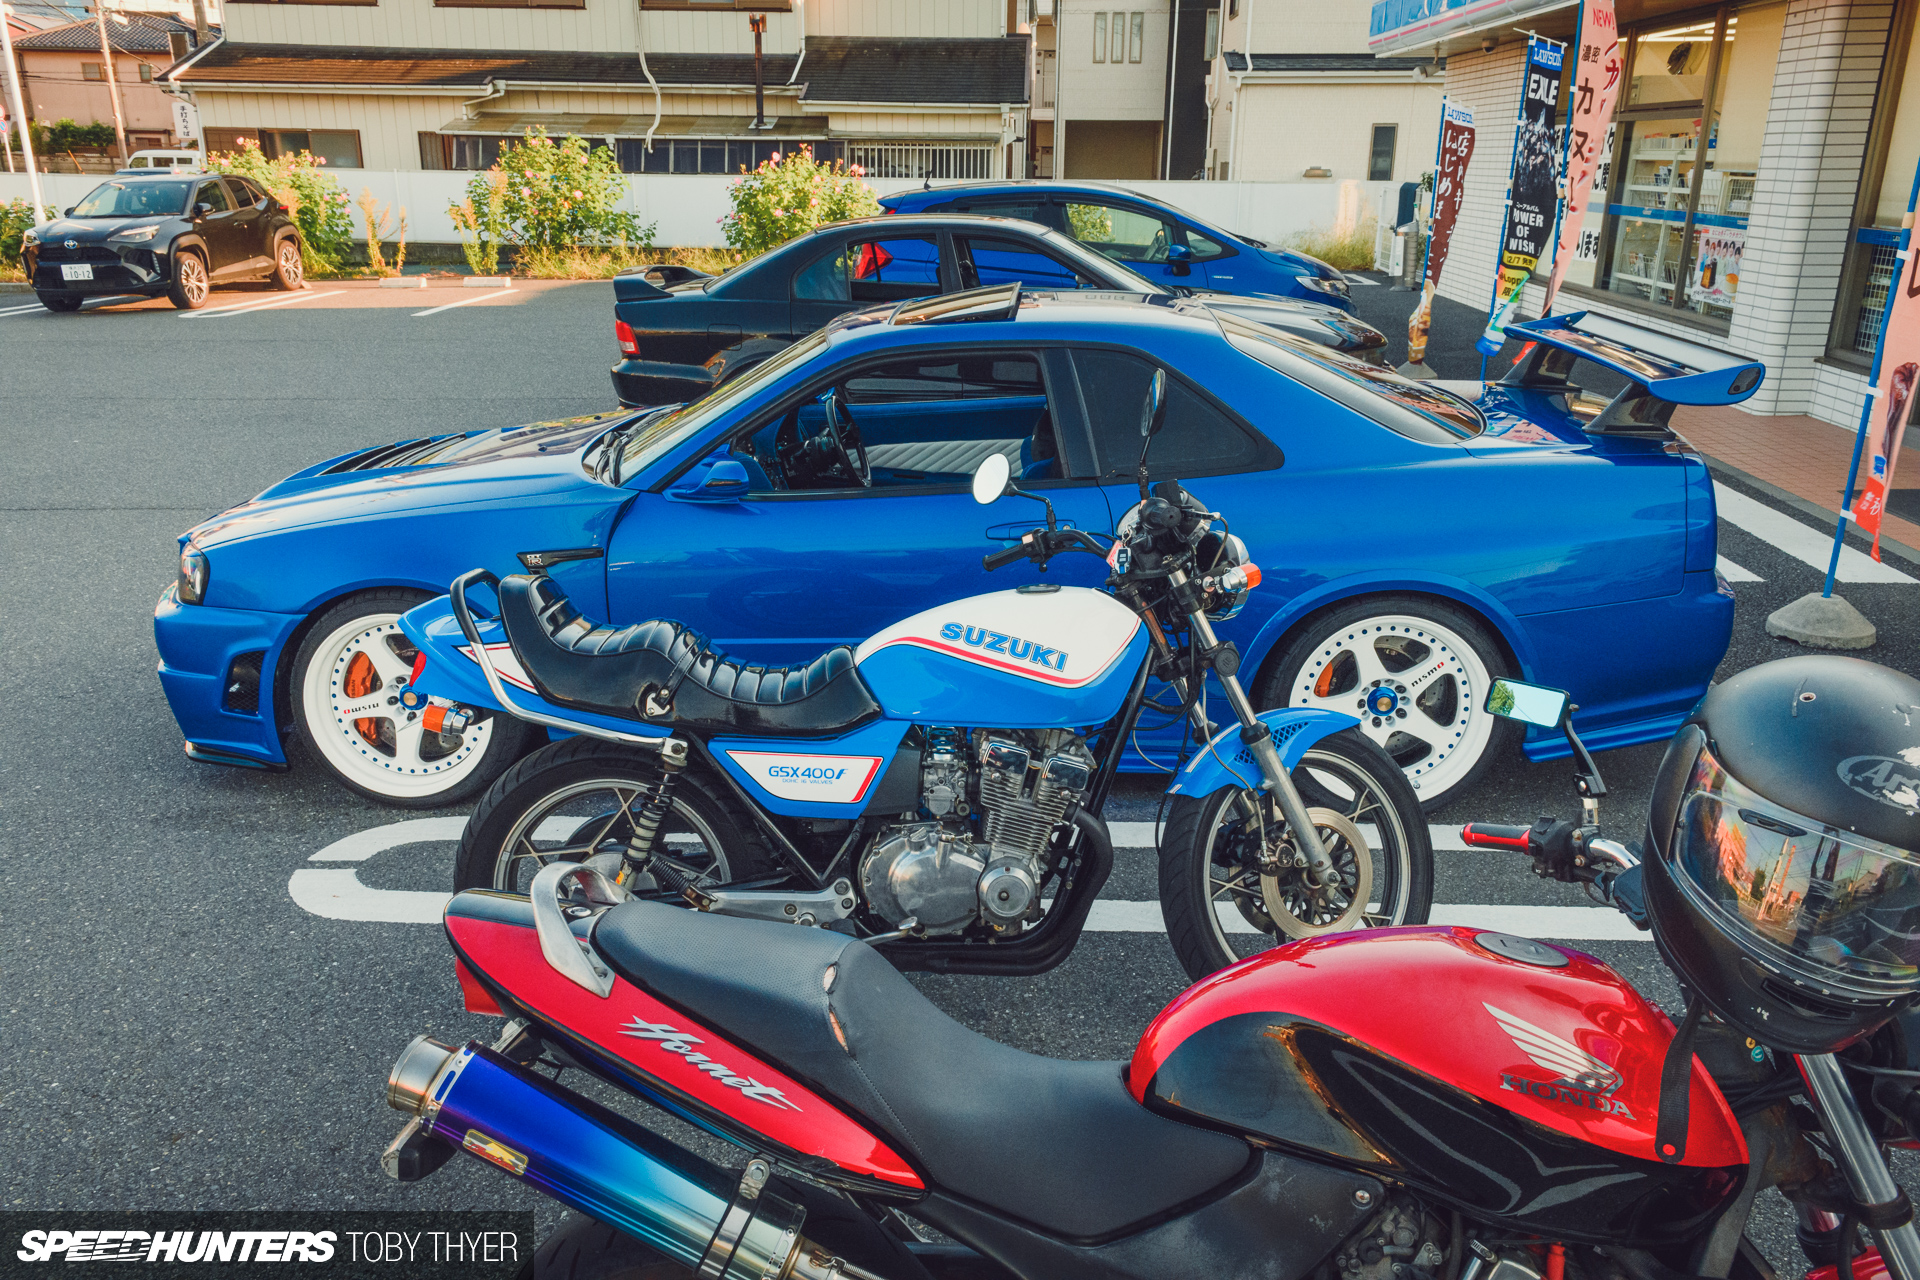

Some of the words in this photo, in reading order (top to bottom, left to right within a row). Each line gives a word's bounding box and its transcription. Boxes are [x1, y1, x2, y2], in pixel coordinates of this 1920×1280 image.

[1592, 8, 1615, 30] NEW!
[1533, 47, 1562, 66] LAWSON
[1447, 107, 1474, 123] LAWSON
[1516, 225, 1530, 239] OF
[70, 270, 91, 279] 10-12
[940, 622, 1068, 672] SUZUKI
[1411, 661, 1444, 687] nismo
[616, 1015, 803, 1112] Hornet
[1500, 1073, 1637, 1120] HONDA
